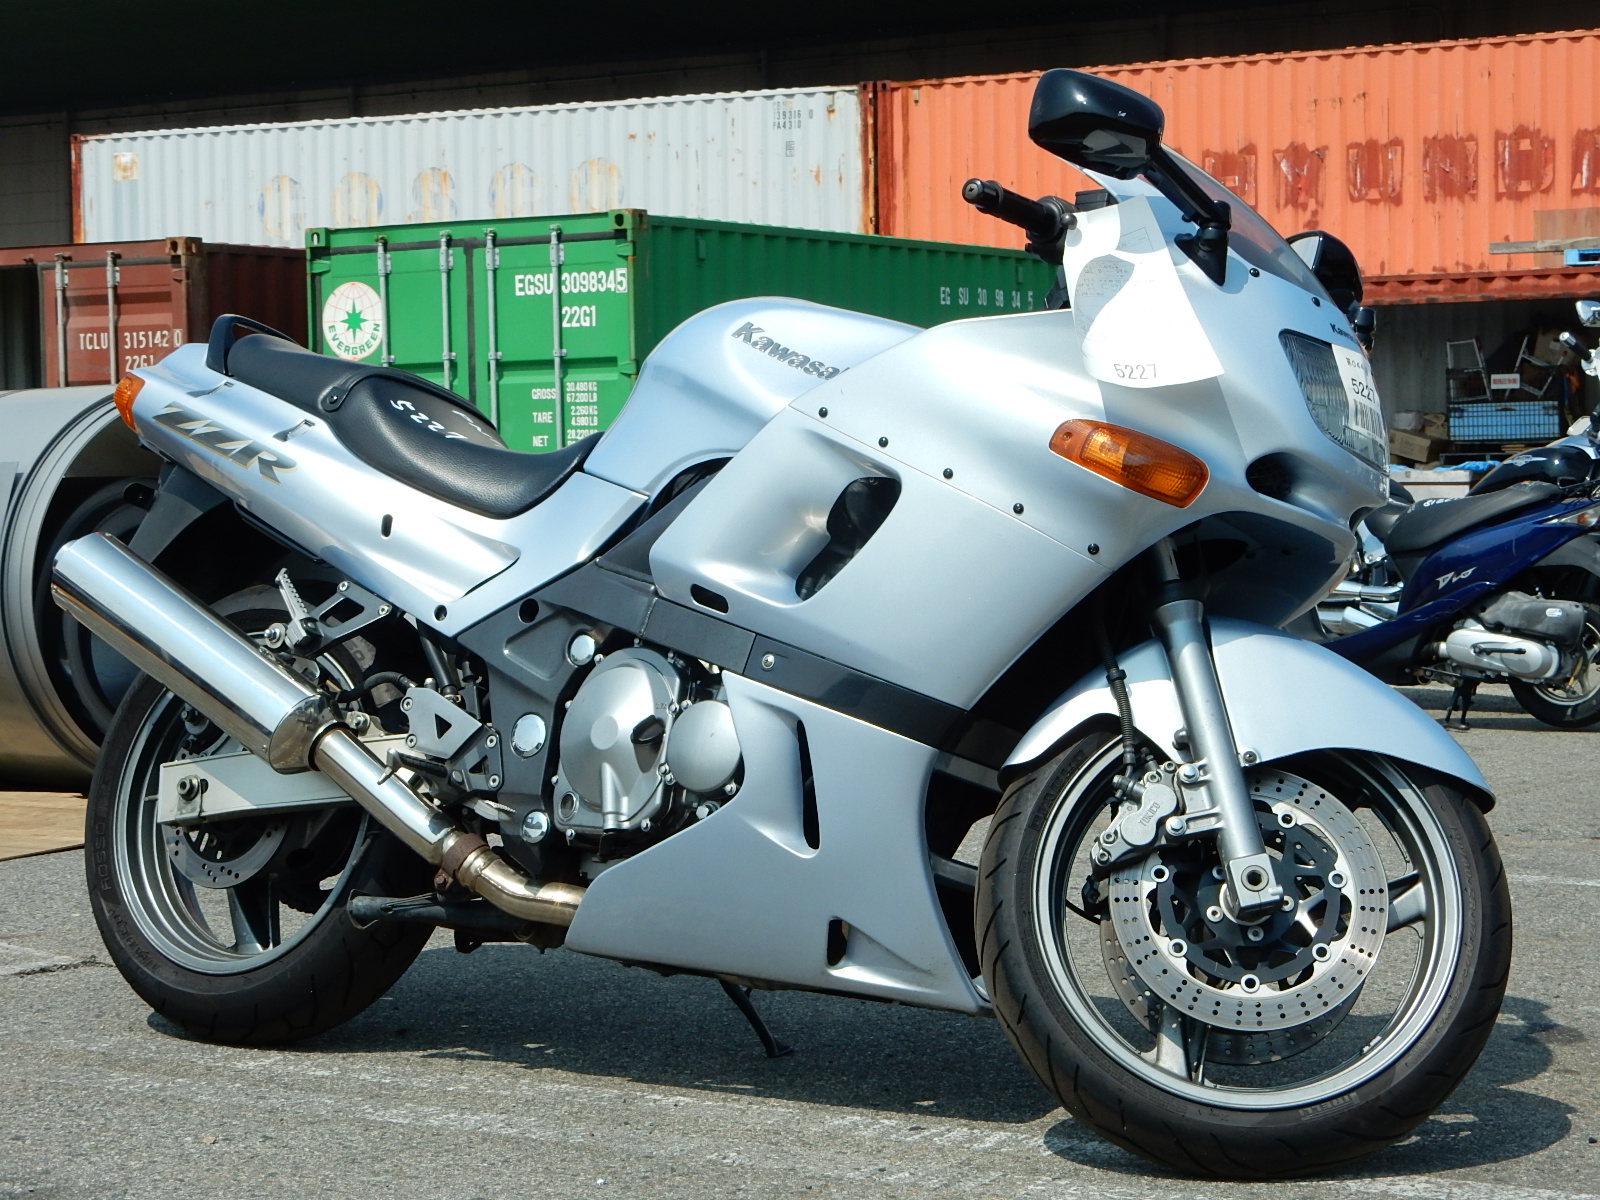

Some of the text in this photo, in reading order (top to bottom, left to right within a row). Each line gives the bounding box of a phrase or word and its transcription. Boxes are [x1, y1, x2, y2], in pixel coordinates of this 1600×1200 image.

[515, 268, 628, 296] EGSU 3098345
[940, 287, 951, 305] EG
[958, 287, 969, 305] SU
[978, 287, 987, 306] 30
[995, 289, 1004, 308] 98
[562, 305, 596, 327] 22G1
[79, 332, 109, 350] TCLU
[123, 331, 169, 349] 315142
[328, 323, 381, 355] EVERGREEN
[731, 321, 851, 380] Kawasa
[1114, 363, 1157, 379] 5227
[531, 388, 557, 399] GROSS
[589, 382, 598, 391] KG
[1351, 378, 1376, 404] 5227
[589, 392, 598, 402] LB
[532, 411, 553, 423] TARE
[589, 405, 598, 415] KG
[589, 416, 598, 426] LB
[532, 435, 549, 447] NET
[1138, 802, 1160, 826] TOKICO
[95, 821, 112, 890] ROSSO
[1298, 1092, 1361, 1121] PIRELLI
